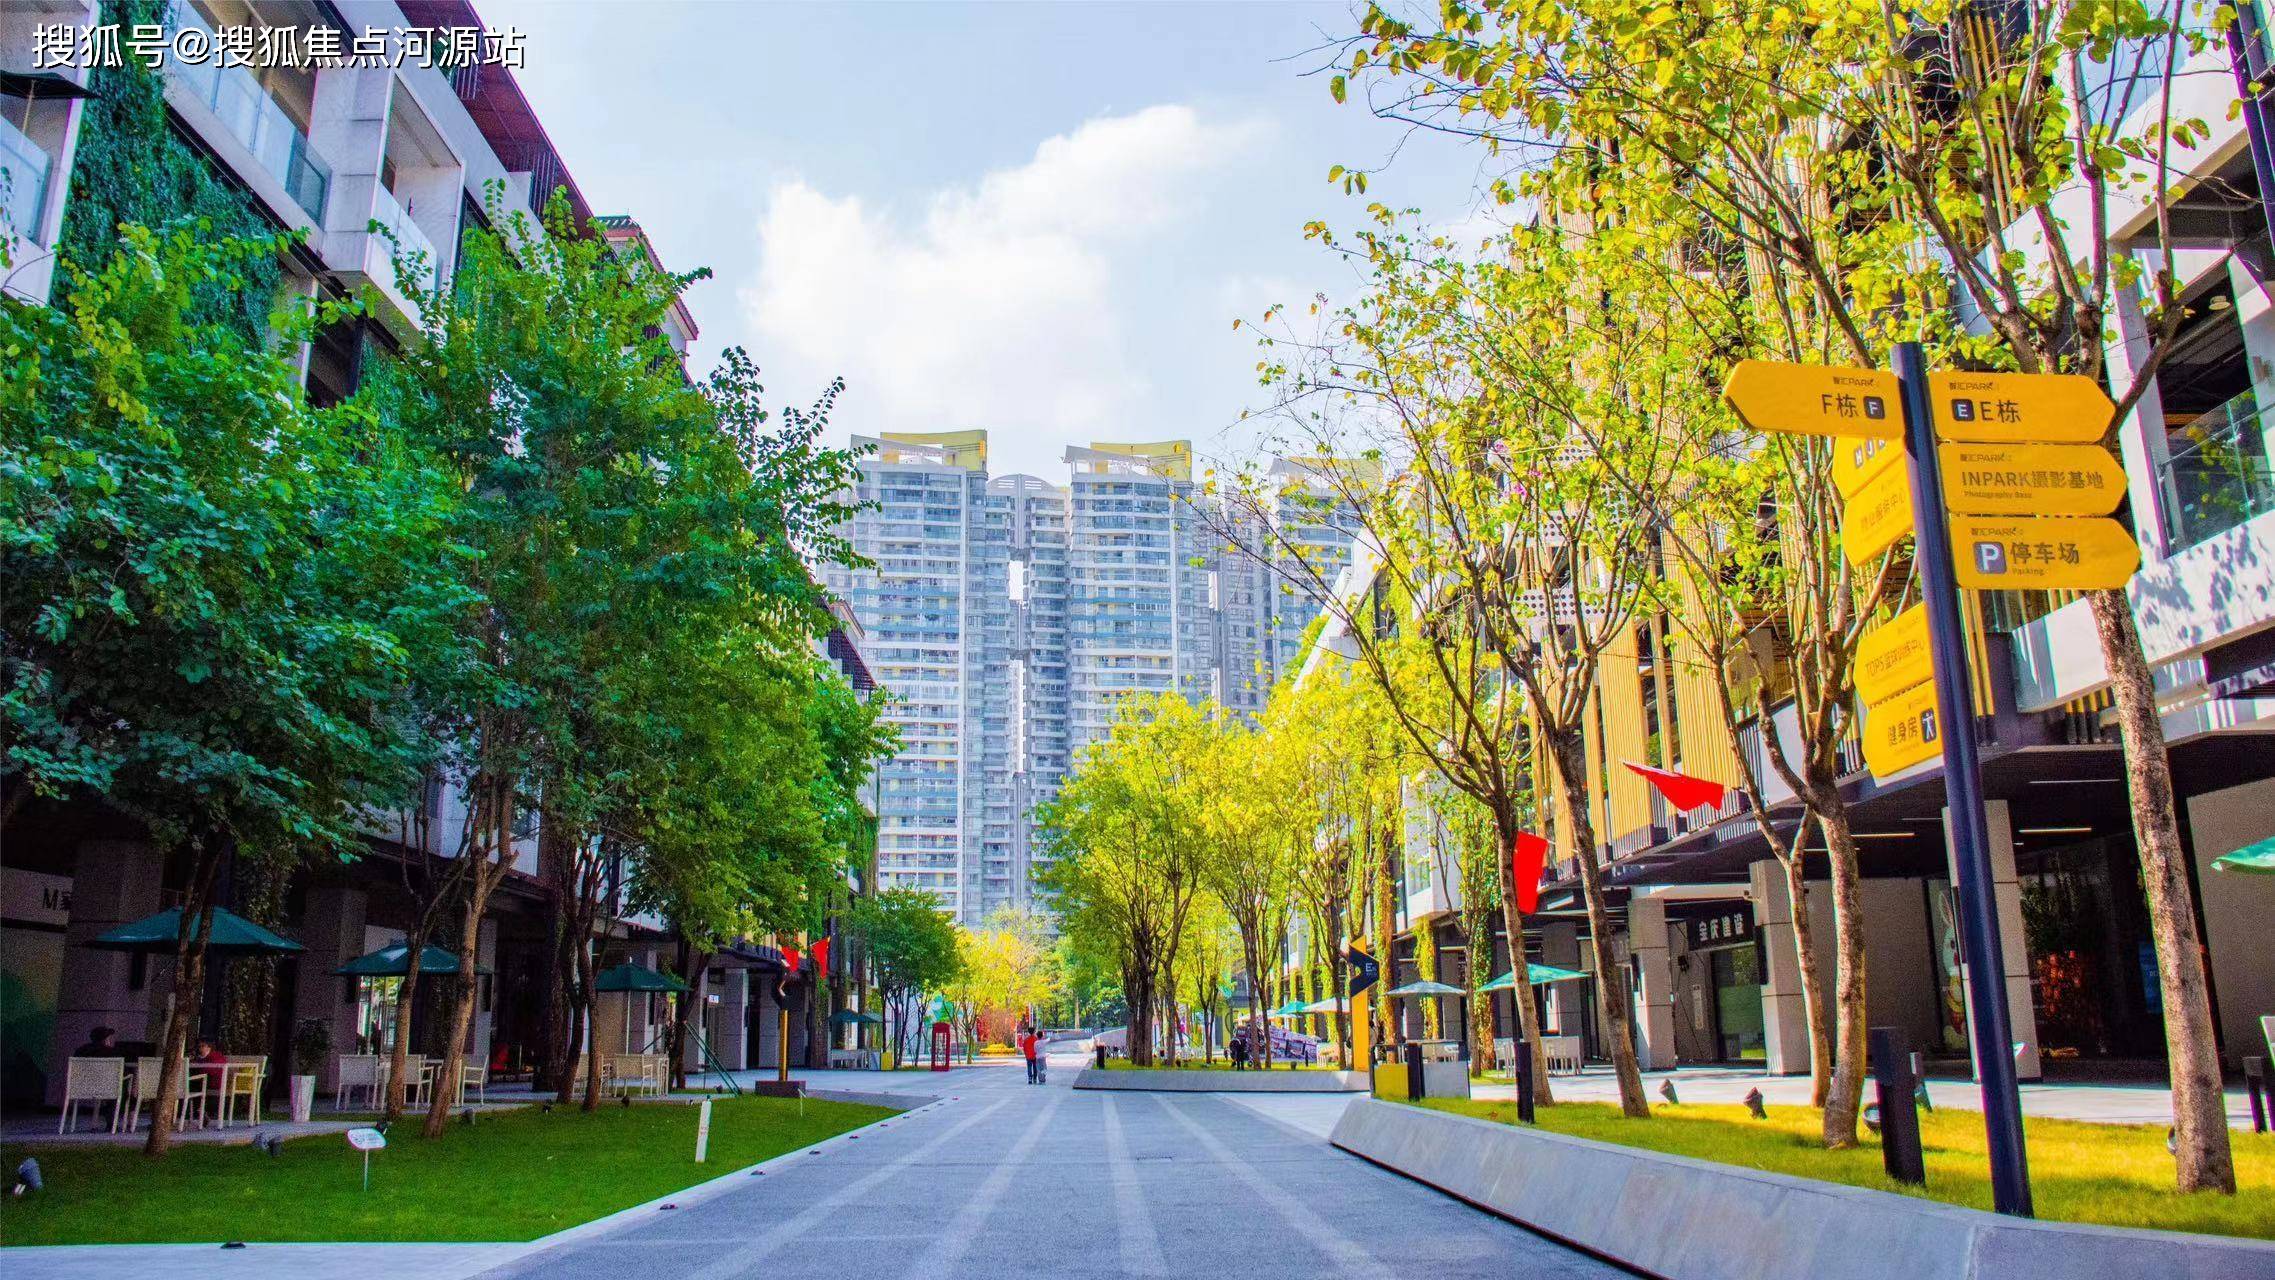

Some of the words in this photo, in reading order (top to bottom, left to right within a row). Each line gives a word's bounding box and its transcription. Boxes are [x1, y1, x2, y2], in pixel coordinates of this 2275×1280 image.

[1822, 393, 1859, 417] F栋
[1868, 401, 1879, 415] F
[1957, 403, 1969, 418] E
[1980, 400, 2021, 423] E栋
[1962, 470, 2104, 489] INPARK摄影基地
[1980, 543, 2000, 572] P
[2010, 542, 2080, 565] 停车场
[2012, 567, 2045, 576] Parking
